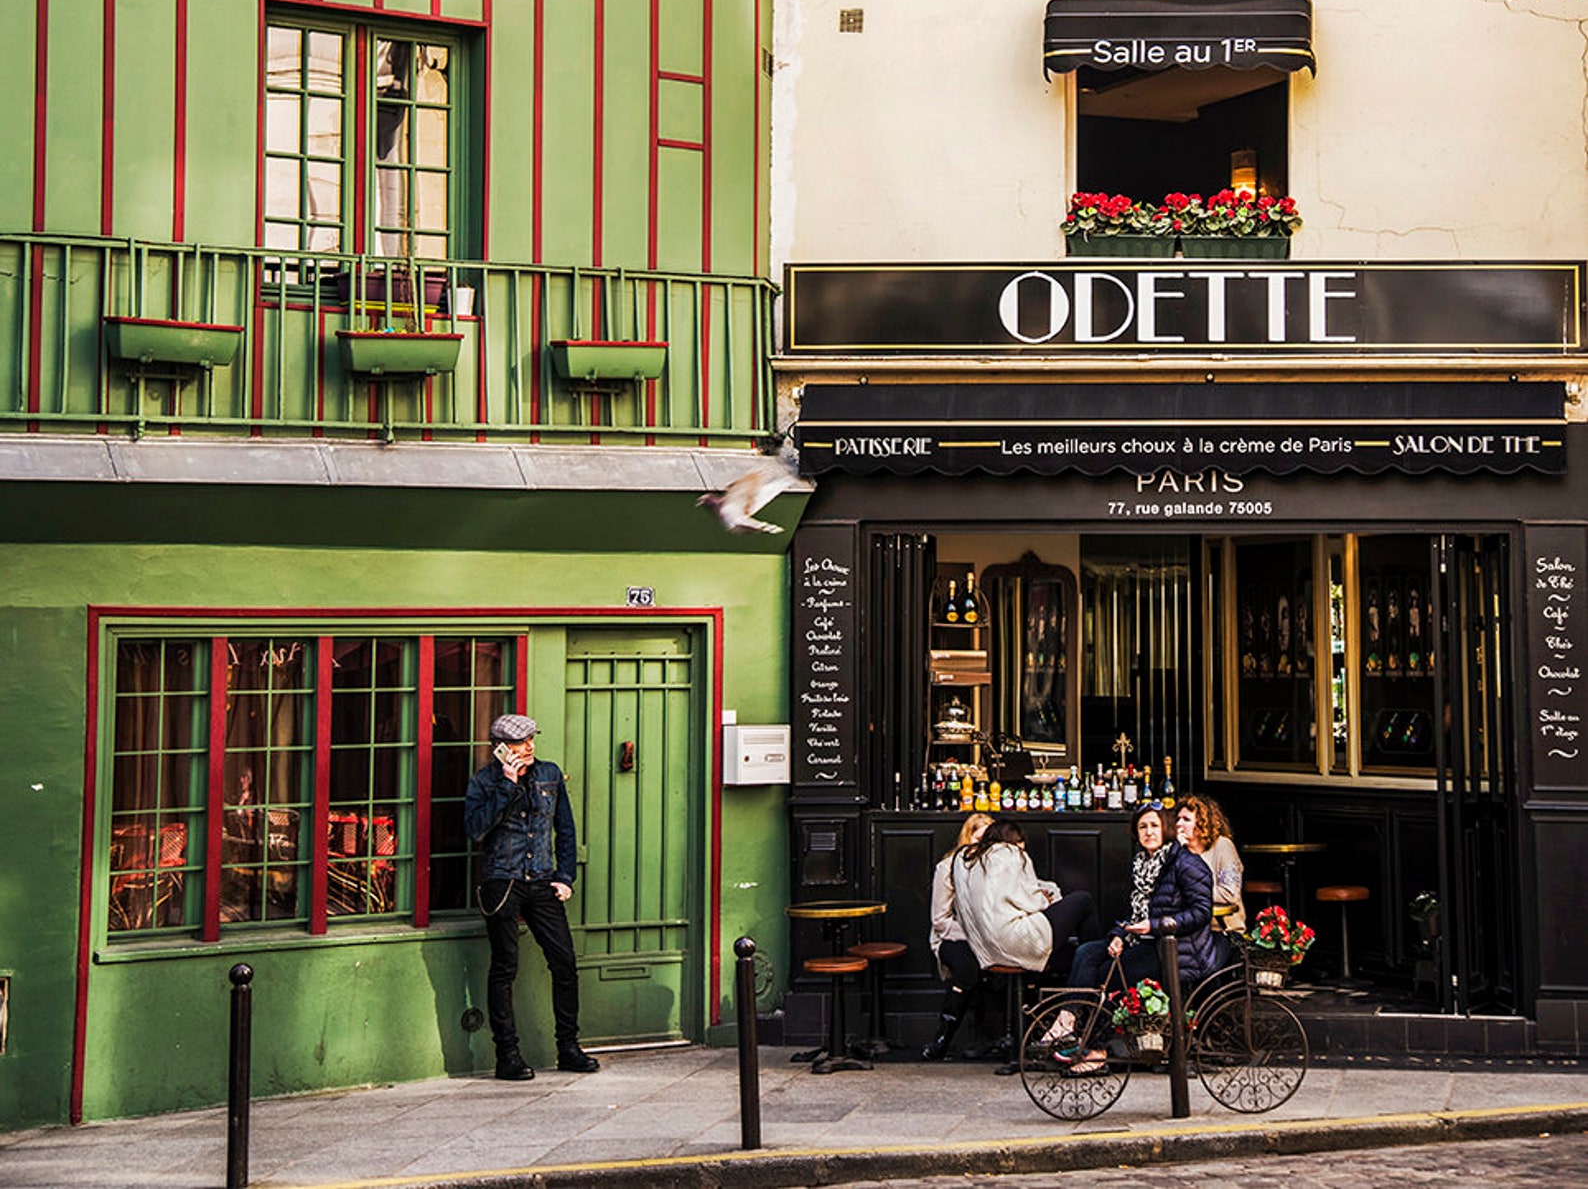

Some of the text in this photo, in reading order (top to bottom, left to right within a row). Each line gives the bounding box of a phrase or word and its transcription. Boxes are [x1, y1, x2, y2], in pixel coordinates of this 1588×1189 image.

[1092, 39, 1166, 63] Salle
[1175, 45, 1210, 63] au
[999, 271, 1357, 344] ODETTE
[836, 438, 931, 456] PATISSERIE
[1002, 438, 1352, 454] Les meilleurs choux à la crème de Paris
[1393, 436, 1539, 455] SALON DE THE
[1138, 472, 1243, 492] PARIS
[1108, 502, 1272, 517] 77, rue galande 75005
[1536, 557, 1575, 573] Salon
[629, 590, 651, 604] 75
[1543, 606, 1569, 624] Café
